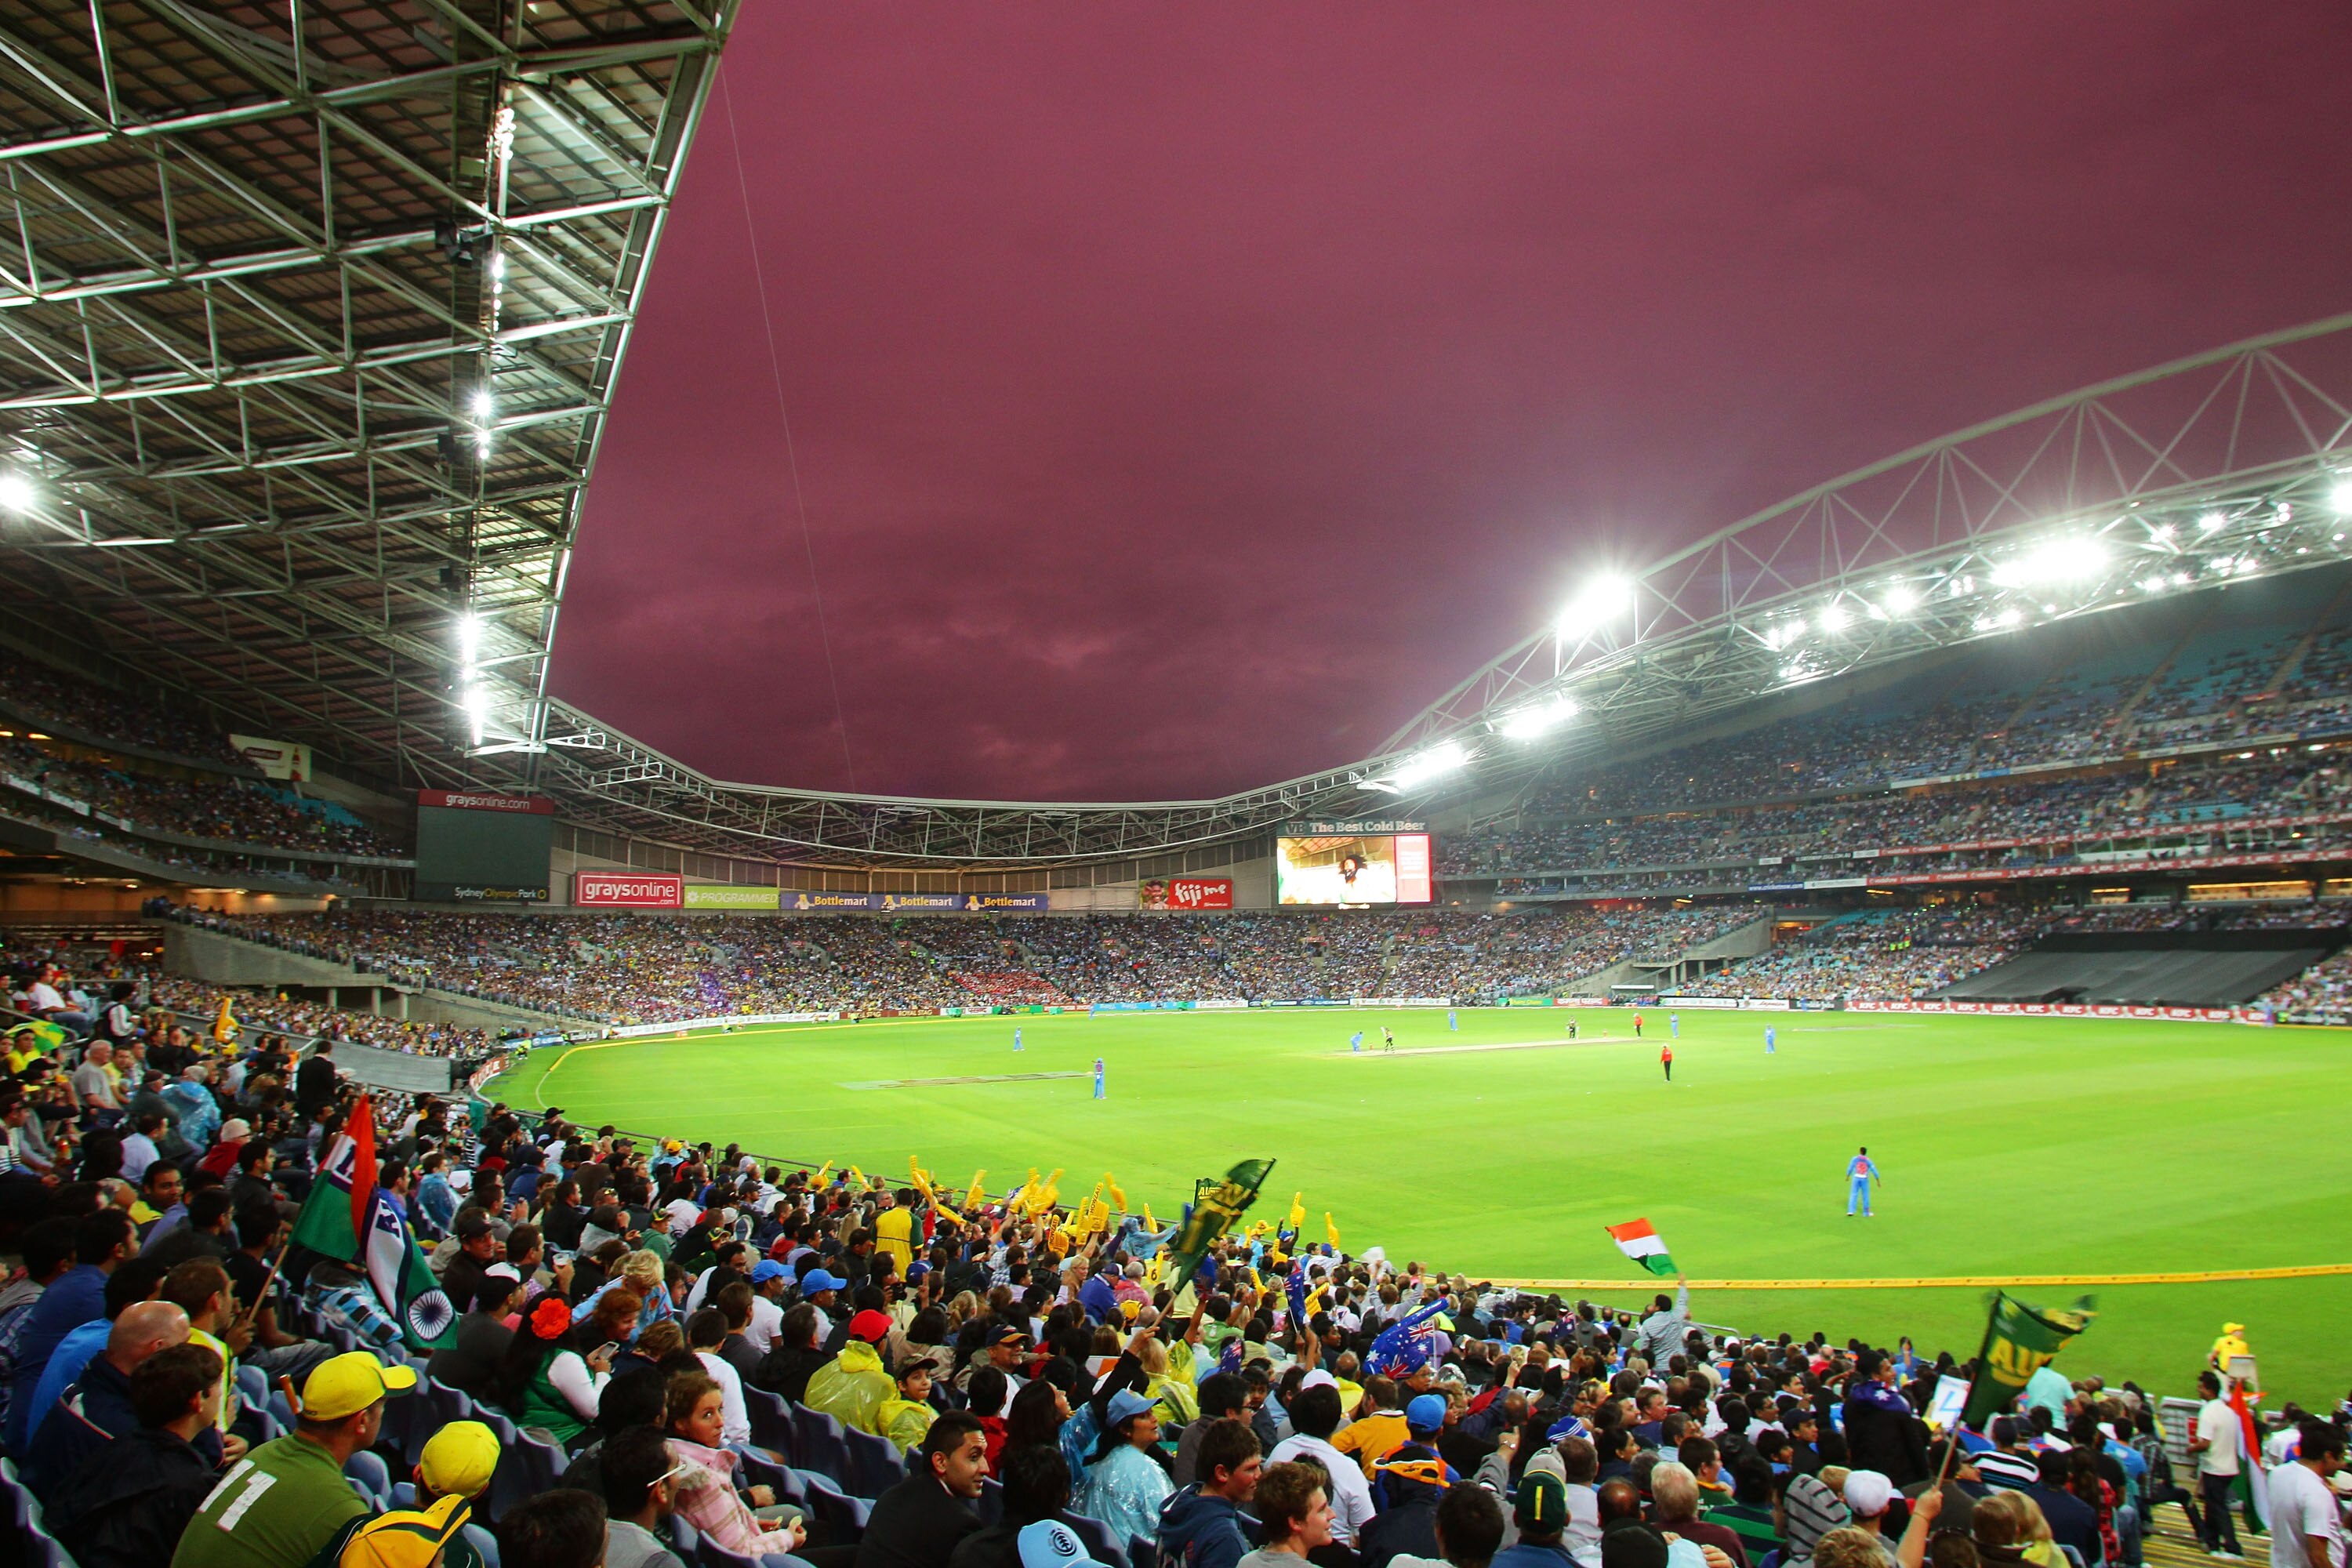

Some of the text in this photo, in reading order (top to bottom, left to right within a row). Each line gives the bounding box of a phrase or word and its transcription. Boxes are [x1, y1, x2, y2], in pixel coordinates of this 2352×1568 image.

[445, 793, 530, 810] graysonline.com
[1309, 821, 1425, 833] The Best Cold Beer
[586, 882, 675, 900] graysonline
[1174, 882, 1226, 906] fiji me
[699, 892, 778, 903] PROGRAMMED
[814, 895, 868, 907] Bottlemart
[900, 895, 953, 907] Bottlemart
[984, 895, 1036, 907] Bottlemart
[1151, 1268, 1157, 1281] 6
